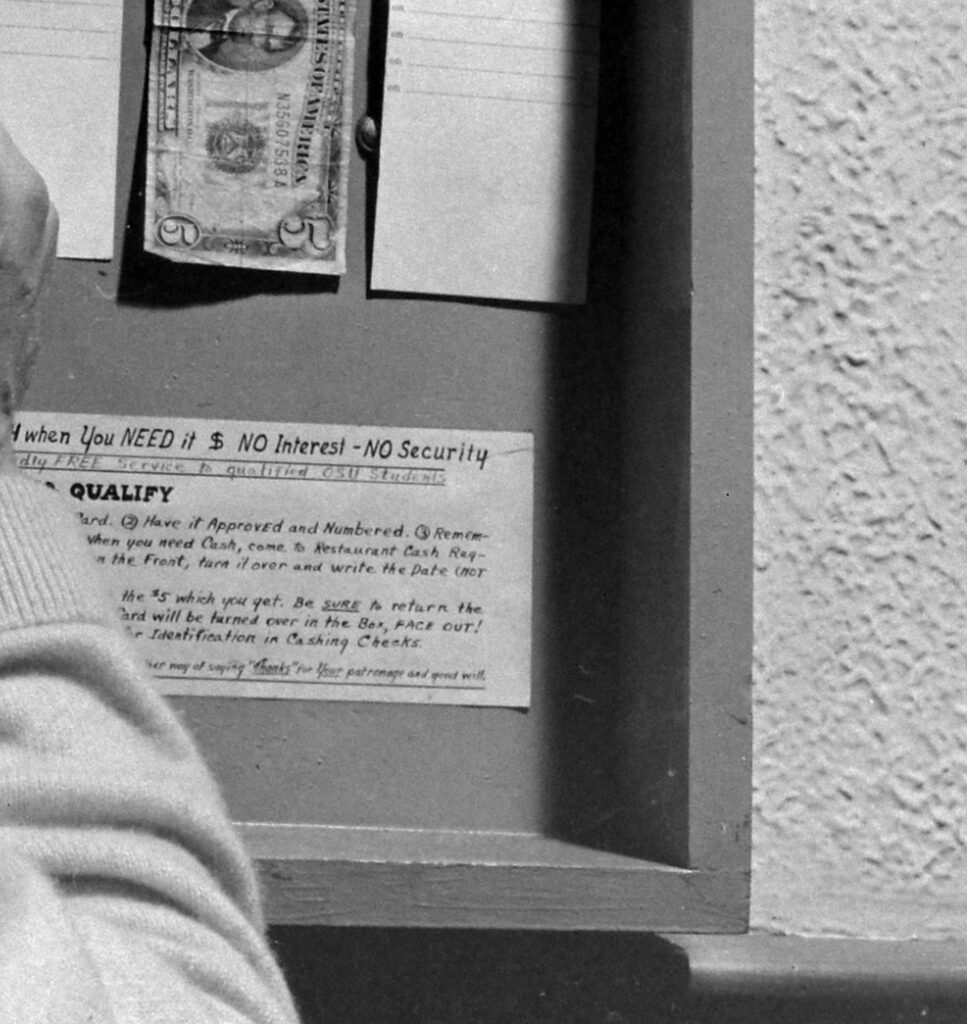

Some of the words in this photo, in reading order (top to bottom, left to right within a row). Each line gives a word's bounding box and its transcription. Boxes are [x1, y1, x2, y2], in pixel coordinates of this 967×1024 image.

[310, 67, 325, 94] OF
[295, 97, 323, 185] AMERICA
[158, 216, 200, 248] 5
[278, 215, 333, 254] 5
[24, 425, 70, 445] when
[80, 425, 115, 454] You
[120, 427, 175, 449] NEED
[181, 431, 196, 451] it
[208, 431, 224, 451] $
[238, 432, 269, 453] NO
[274, 432, 346, 456] Interest
[398, 439, 490, 471] Security
[53, 454, 103, 470] FREE
[69, 482, 175, 503] QUALIFY
[142, 514, 182, 529] Have
[189, 515, 204, 530] it
[288, 520, 319, 535] and
[323, 521, 410, 538] Numbered.
[126, 537, 154, 555] you
[159, 535, 194, 551] need
[200, 536, 243, 554] Cash,
[248, 542, 286, 554] come
[293, 540, 305, 554] to
[313, 541, 399, 559] Restaurant
[403, 544, 440, 559] Cash
[111, 552, 136, 567] the
[143, 553, 190, 571] Front,
[198, 554, 230, 569] turn
[236, 556, 249, 571] it
[250, 560, 288, 572] over
[293, 561, 323, 573] and
[330, 561, 376, 575] write
[382, 562, 407, 576] the
[410, 564, 450, 577] Date
[120, 589, 146, 603] the
[175, 589, 216, 605] which
[221, 593, 248, 610] you
[292, 596, 314, 610] Be
[322, 599, 362, 612] SURE
[369, 599, 382, 612] to
[391, 598, 449, 613] return
[458, 602, 484, 615] the
[151, 608, 182, 623] will
[186, 610, 204, 624] be
[210, 611, 259, 626] turned
[266, 616, 299, 627] over
[304, 615, 319, 627] in
[324, 616, 350, 629] the
[393, 620, 435, 631] FACE
[442, 619, 484, 635] OUT!
[149, 626, 257, 646] Identification
[264, 631, 279, 645] in
[286, 631, 350, 656] Cashing
[356, 634, 424, 650] Checks.
[407, 668, 429, 681] and
